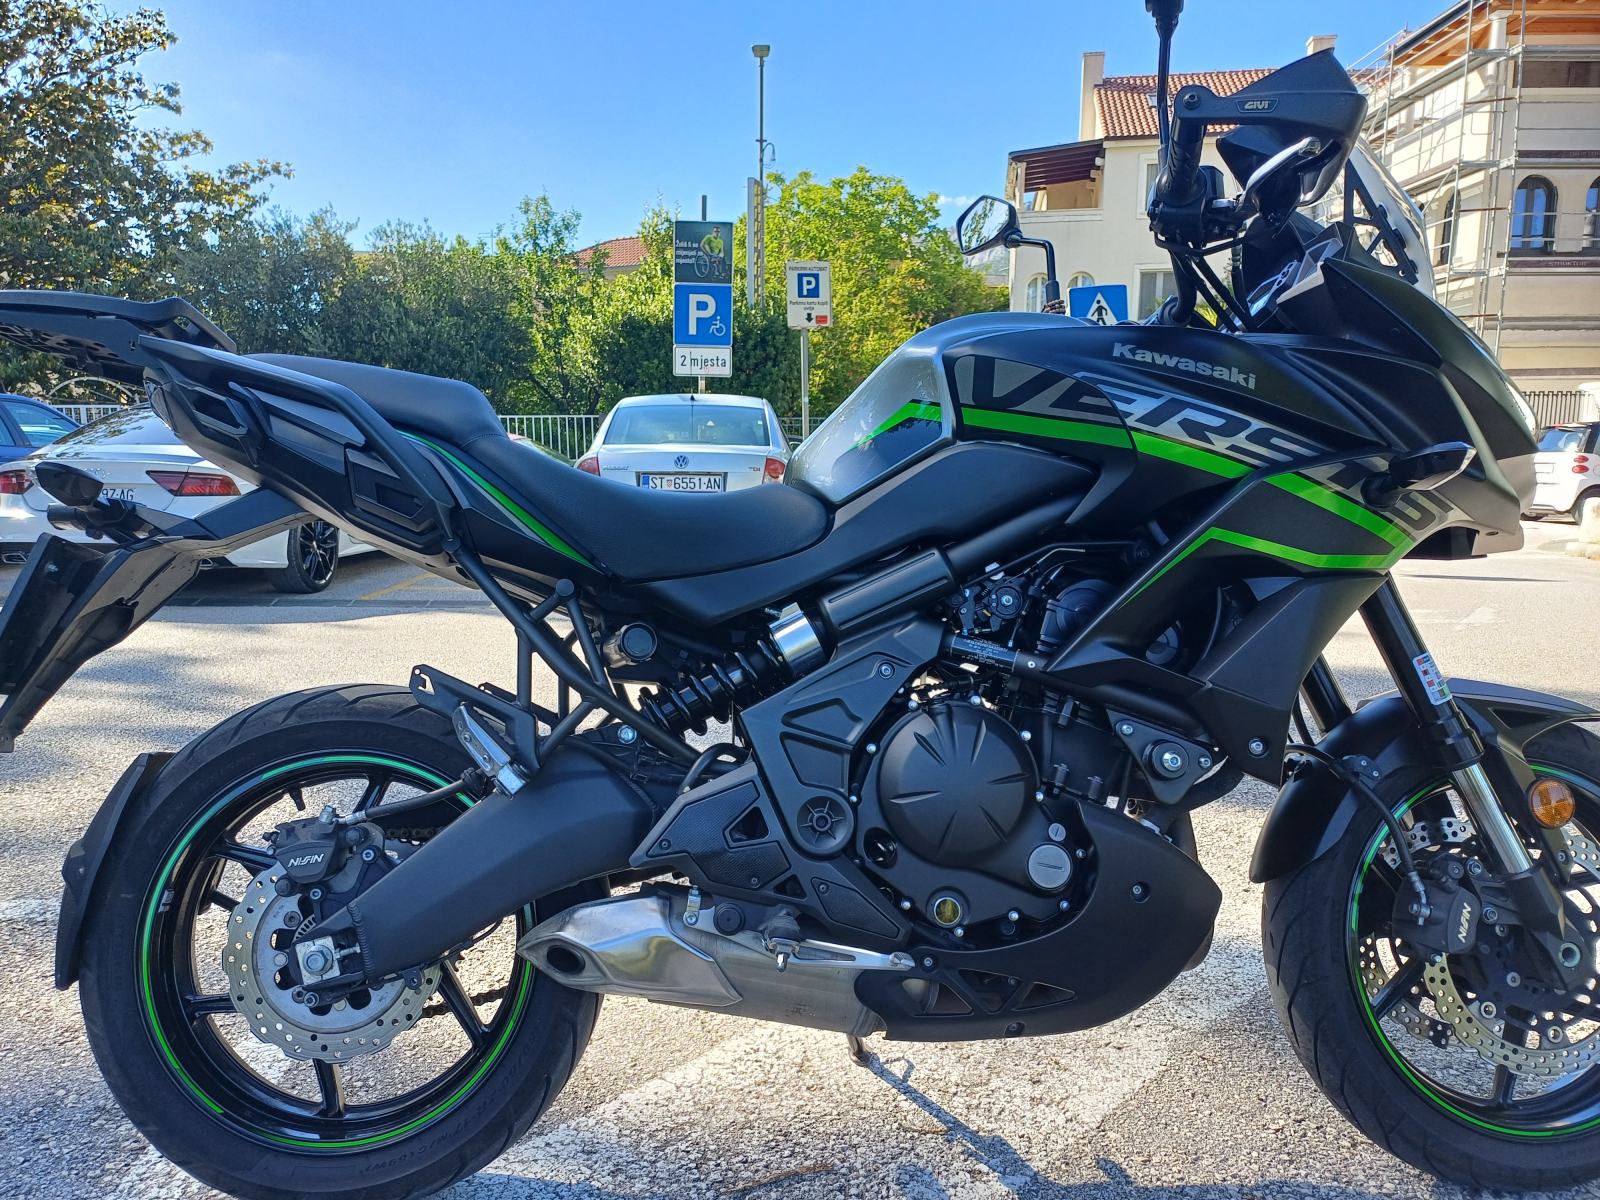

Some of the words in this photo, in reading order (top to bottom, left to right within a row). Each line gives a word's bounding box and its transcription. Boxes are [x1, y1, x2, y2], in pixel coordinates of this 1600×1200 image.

[1244, 100, 1269, 110] GIVI
[802, 276, 816, 296] P
[688, 293, 716, 336] P
[680, 354, 687, 367] 2
[690, 355, 727, 370] mjesta
[1112, 342, 1256, 390] Kawasaki
[650, 477, 667, 490] ST
[288, 853, 324, 868] NISSIN
[1457, 902, 1472, 943] NISSIN
